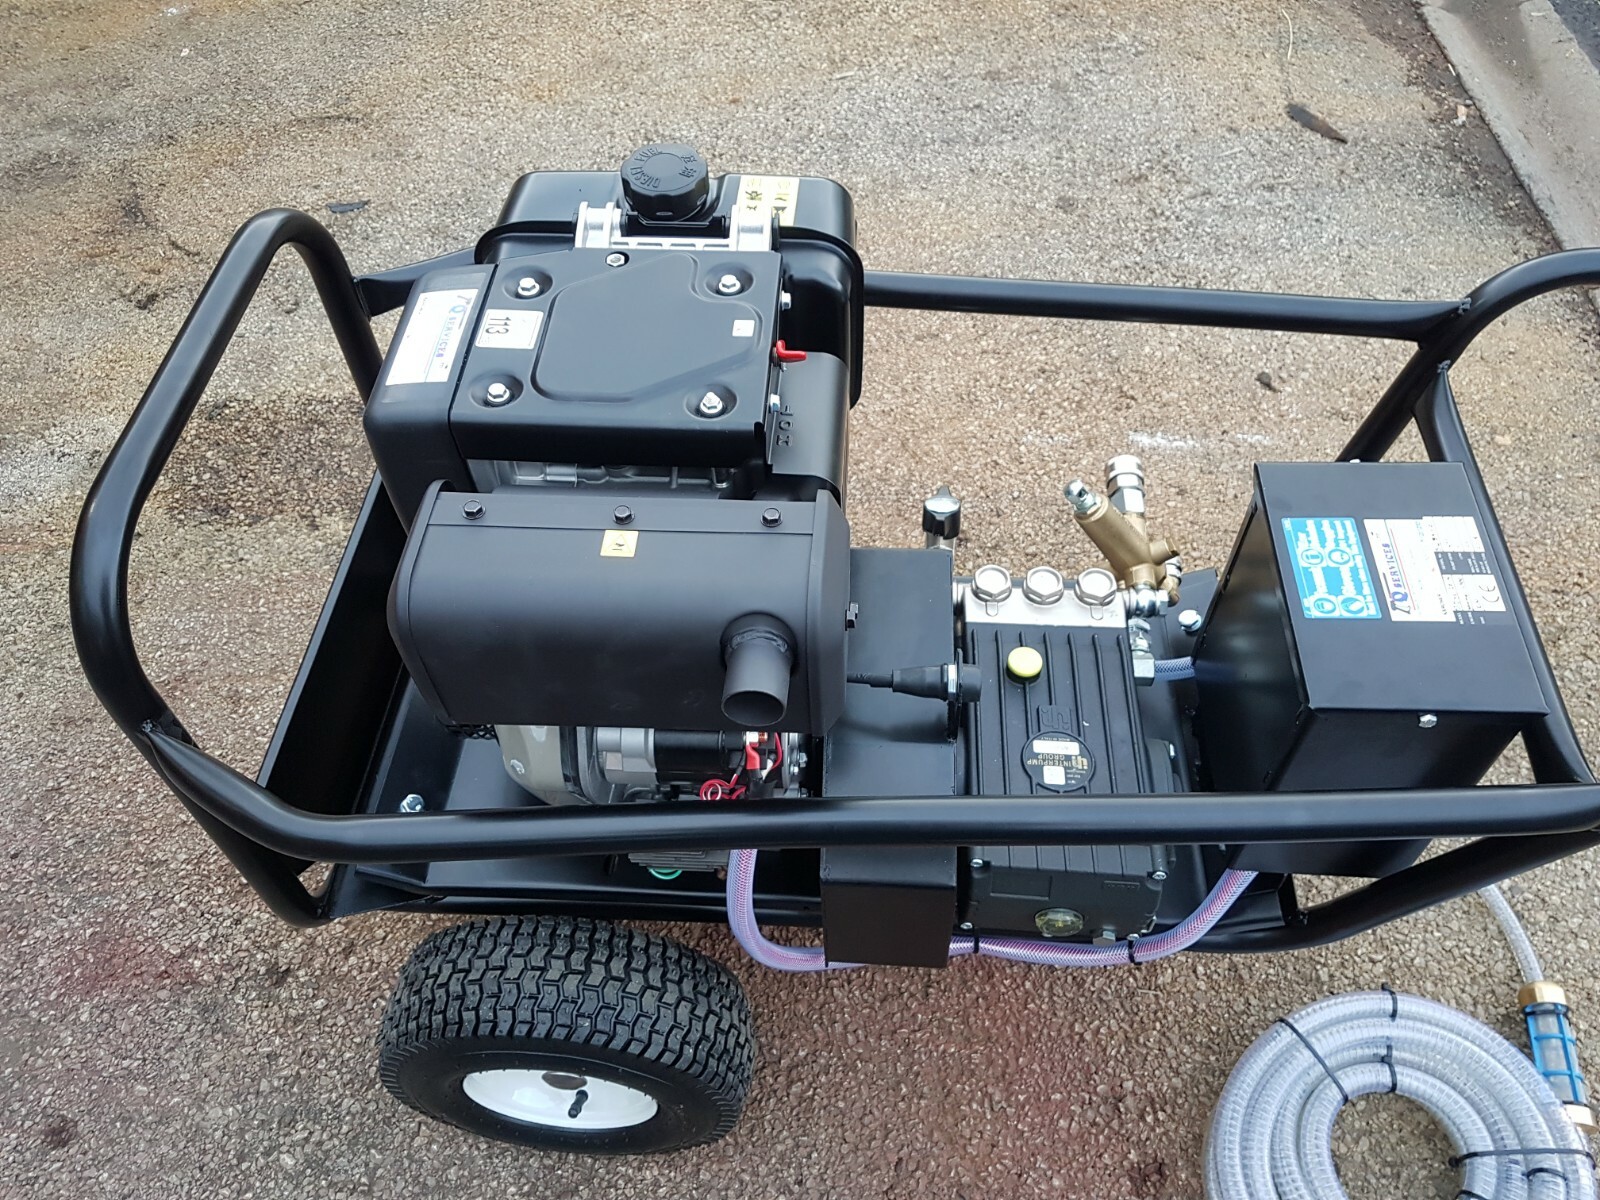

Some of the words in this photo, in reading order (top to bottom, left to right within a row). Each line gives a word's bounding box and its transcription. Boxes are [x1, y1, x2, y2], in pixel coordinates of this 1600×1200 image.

[634, 147, 663, 162] FUEL
[630, 166, 661, 188] DIESEL
[485, 316, 512, 334] 113
[776, 404, 794, 447] HOT
[1381, 543, 1402, 587] SERVICES
[1027, 758, 1071, 767] INTERPUMP
